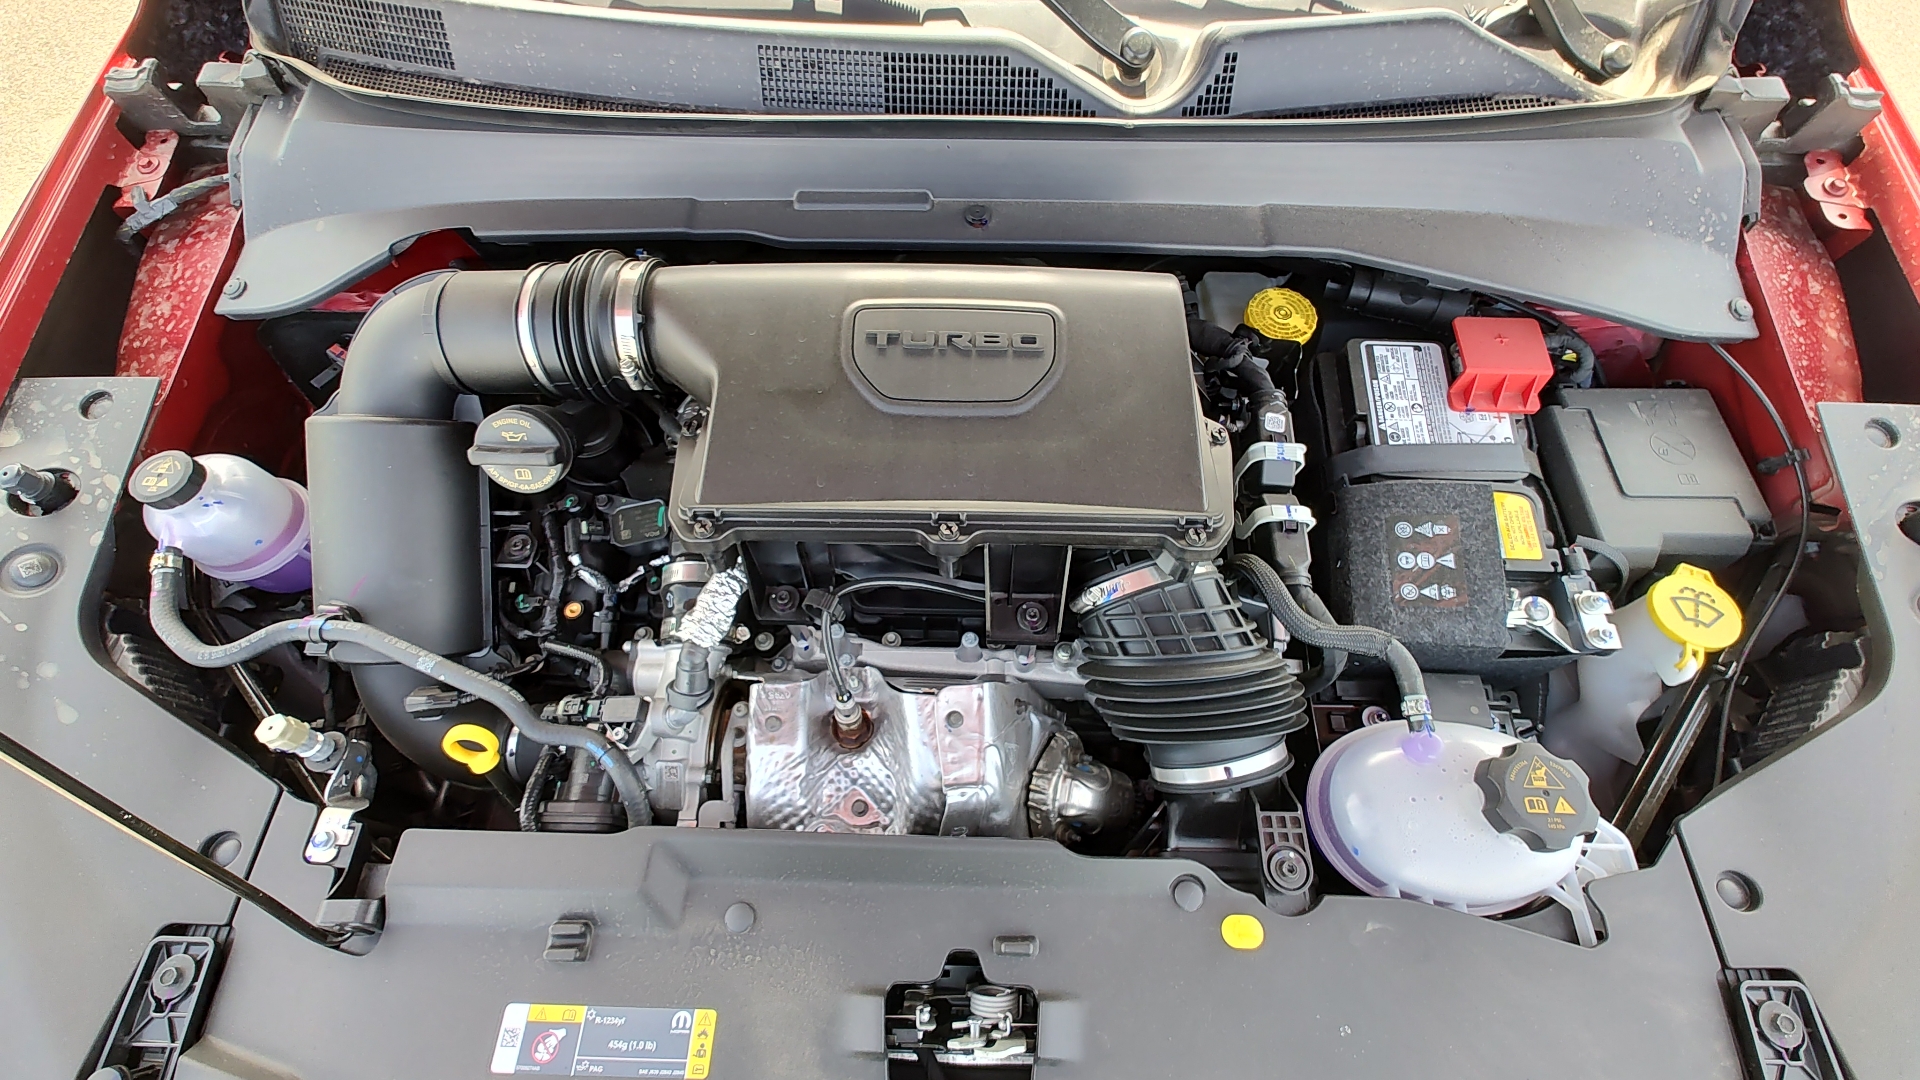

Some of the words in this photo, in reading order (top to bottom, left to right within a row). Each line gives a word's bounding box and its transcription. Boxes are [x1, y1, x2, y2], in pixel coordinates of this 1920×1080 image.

[866, 329, 1045, 352] TURBO
[492, 418, 518, 428] ENGINE
[519, 419, 531, 429] OIL
[487, 467, 499, 478] API
[594, 1016, 626, 1027] R-1234yf
[607, 1040, 628, 1051] 454g
[628, 1040, 644, 1051] (1.0
[644, 1041, 657, 1052] lb)
[588, 1065, 604, 1073] PAG
